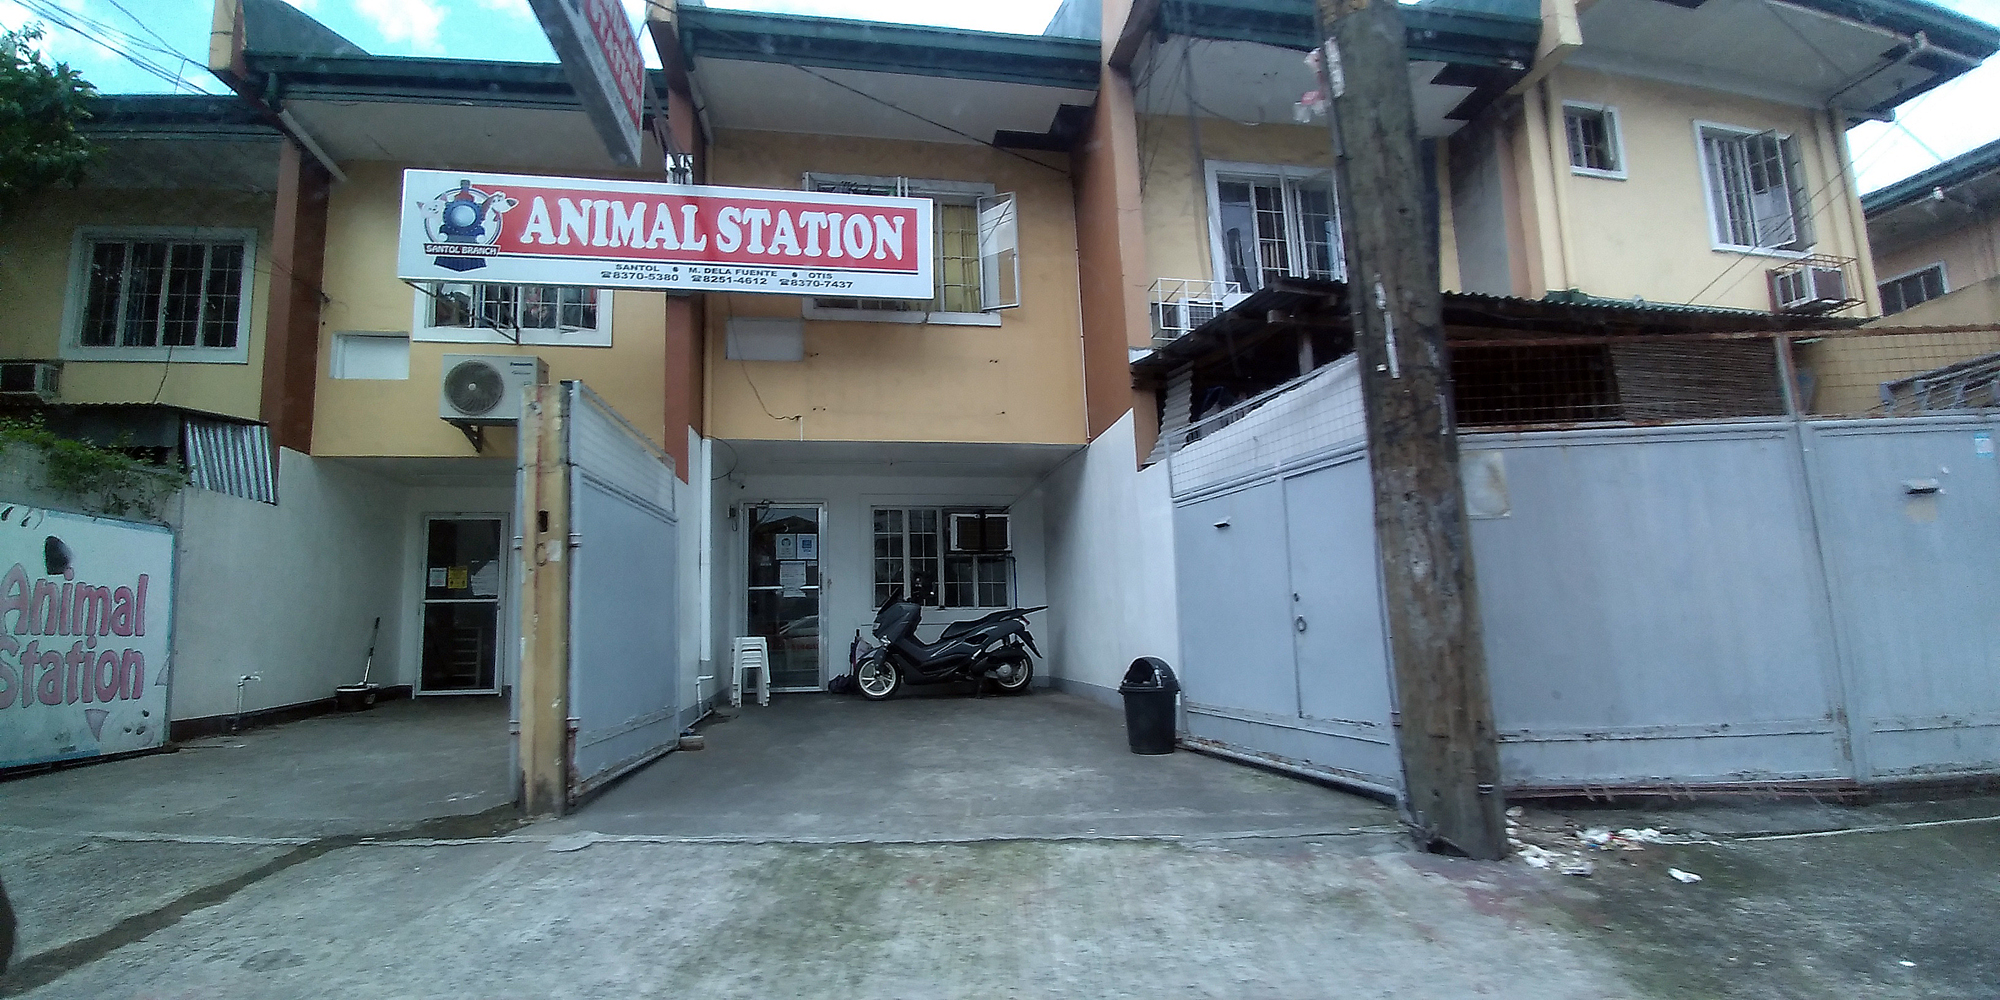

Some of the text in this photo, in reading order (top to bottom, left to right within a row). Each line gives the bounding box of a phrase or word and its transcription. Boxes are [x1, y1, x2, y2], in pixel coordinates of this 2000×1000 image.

[520, 196, 904, 261] ANIMAL STATION
[426, 245, 497, 255] SANTOL BRANCH
[615, 264, 660, 272] SANTOL
[735, 269, 778, 277] FUENTE
[613, 271, 854, 289] 8370-5380 8251-4612 8370-7437
[0, 563, 149, 636] Animal
